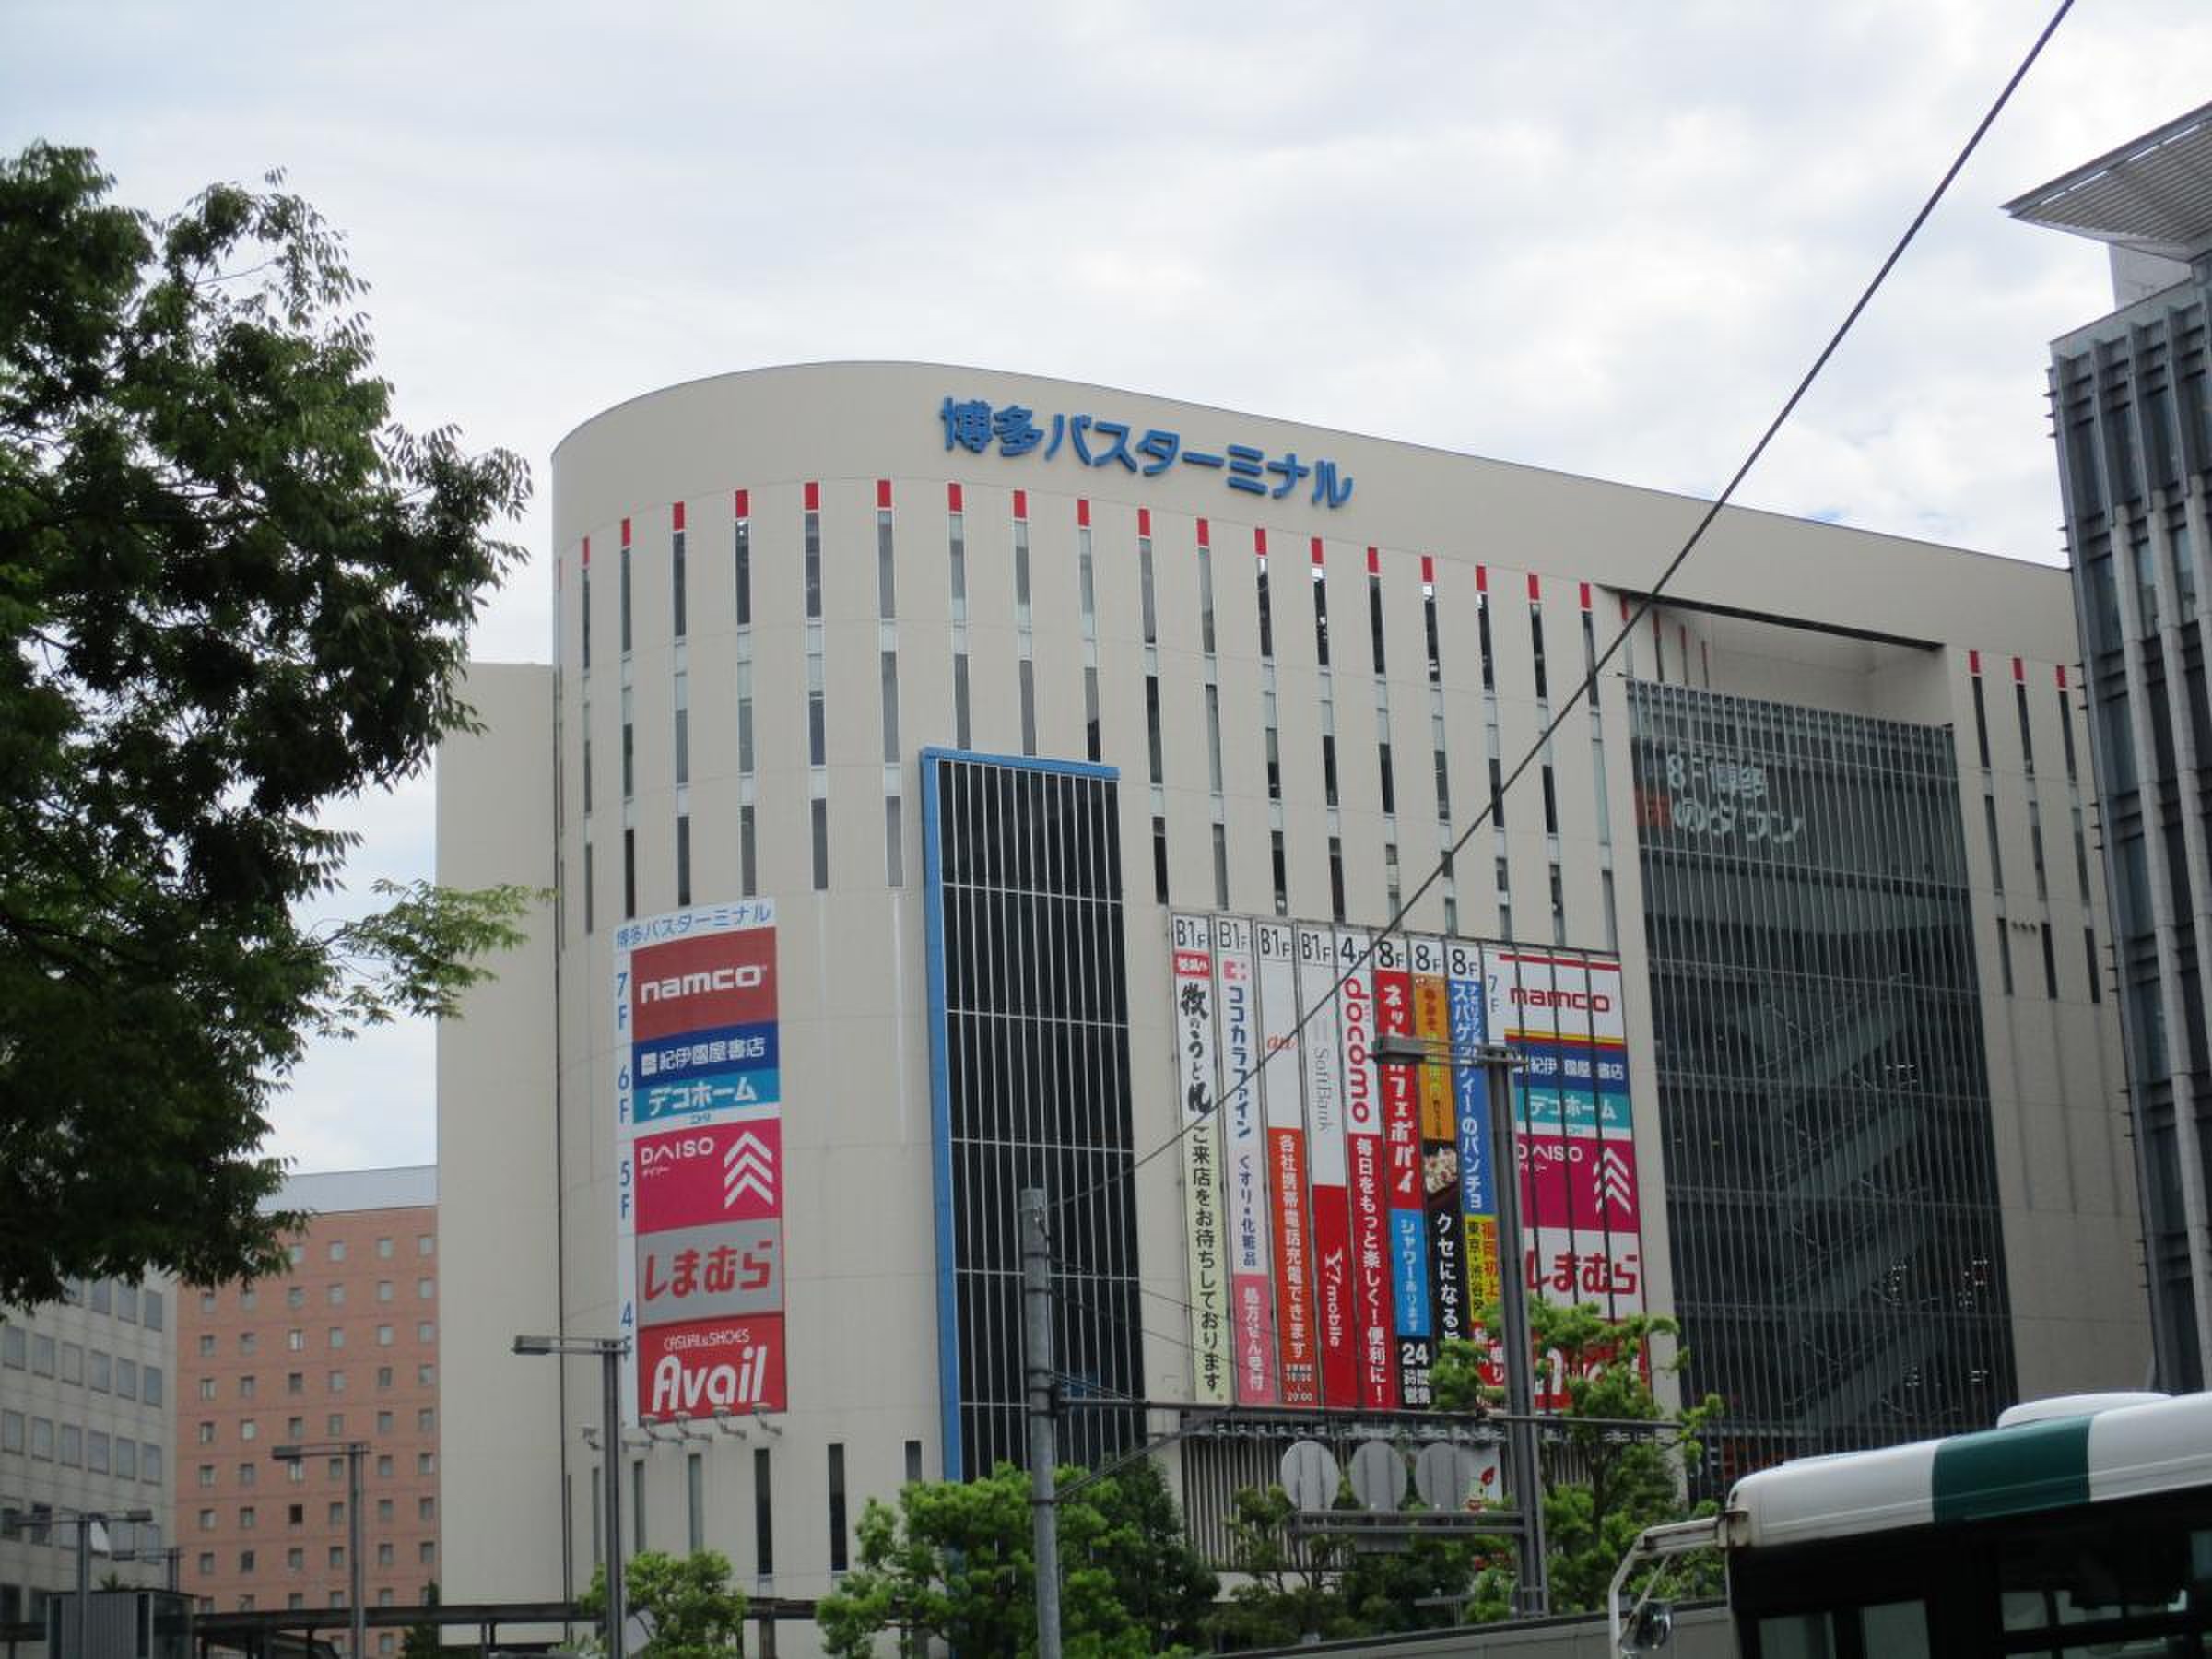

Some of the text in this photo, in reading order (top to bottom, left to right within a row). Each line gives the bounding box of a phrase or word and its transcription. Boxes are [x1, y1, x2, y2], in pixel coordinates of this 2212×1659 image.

[941, 396, 1353, 509] 博多バスターミナル
[617, 903, 771, 946] 博多バスターミナル
[1176, 920, 1206, 948] B1F
[1260, 928, 1291, 957] B1F
[1301, 934, 1331, 959] B1F
[1379, 941, 1405, 969] 8F
[1415, 944, 1441, 971] 8F
[1452, 948, 1478, 976] 8F
[641, 965, 762, 1004] namco
[1510, 987, 1610, 1013] namco
[1228, 986, 1252, 1138] ココカラファイン
[1344, 977, 1371, 1124] docomo
[649, 1077, 758, 1116] デコホーム
[1530, 1094, 1617, 1121] デコホーム
[641, 1136, 714, 1166] DAISO
[645, 1241, 773, 1301] しまむら
[1193, 1126, 1222, 1392] ご来店をお待ちしております
[1525, 1251, 1638, 1295] しまむら
[1325, 1247, 1344, 1348] Y!mobile
[1402, 1342, 1429, 1365] 24
[652, 1345, 768, 1413] Avail
